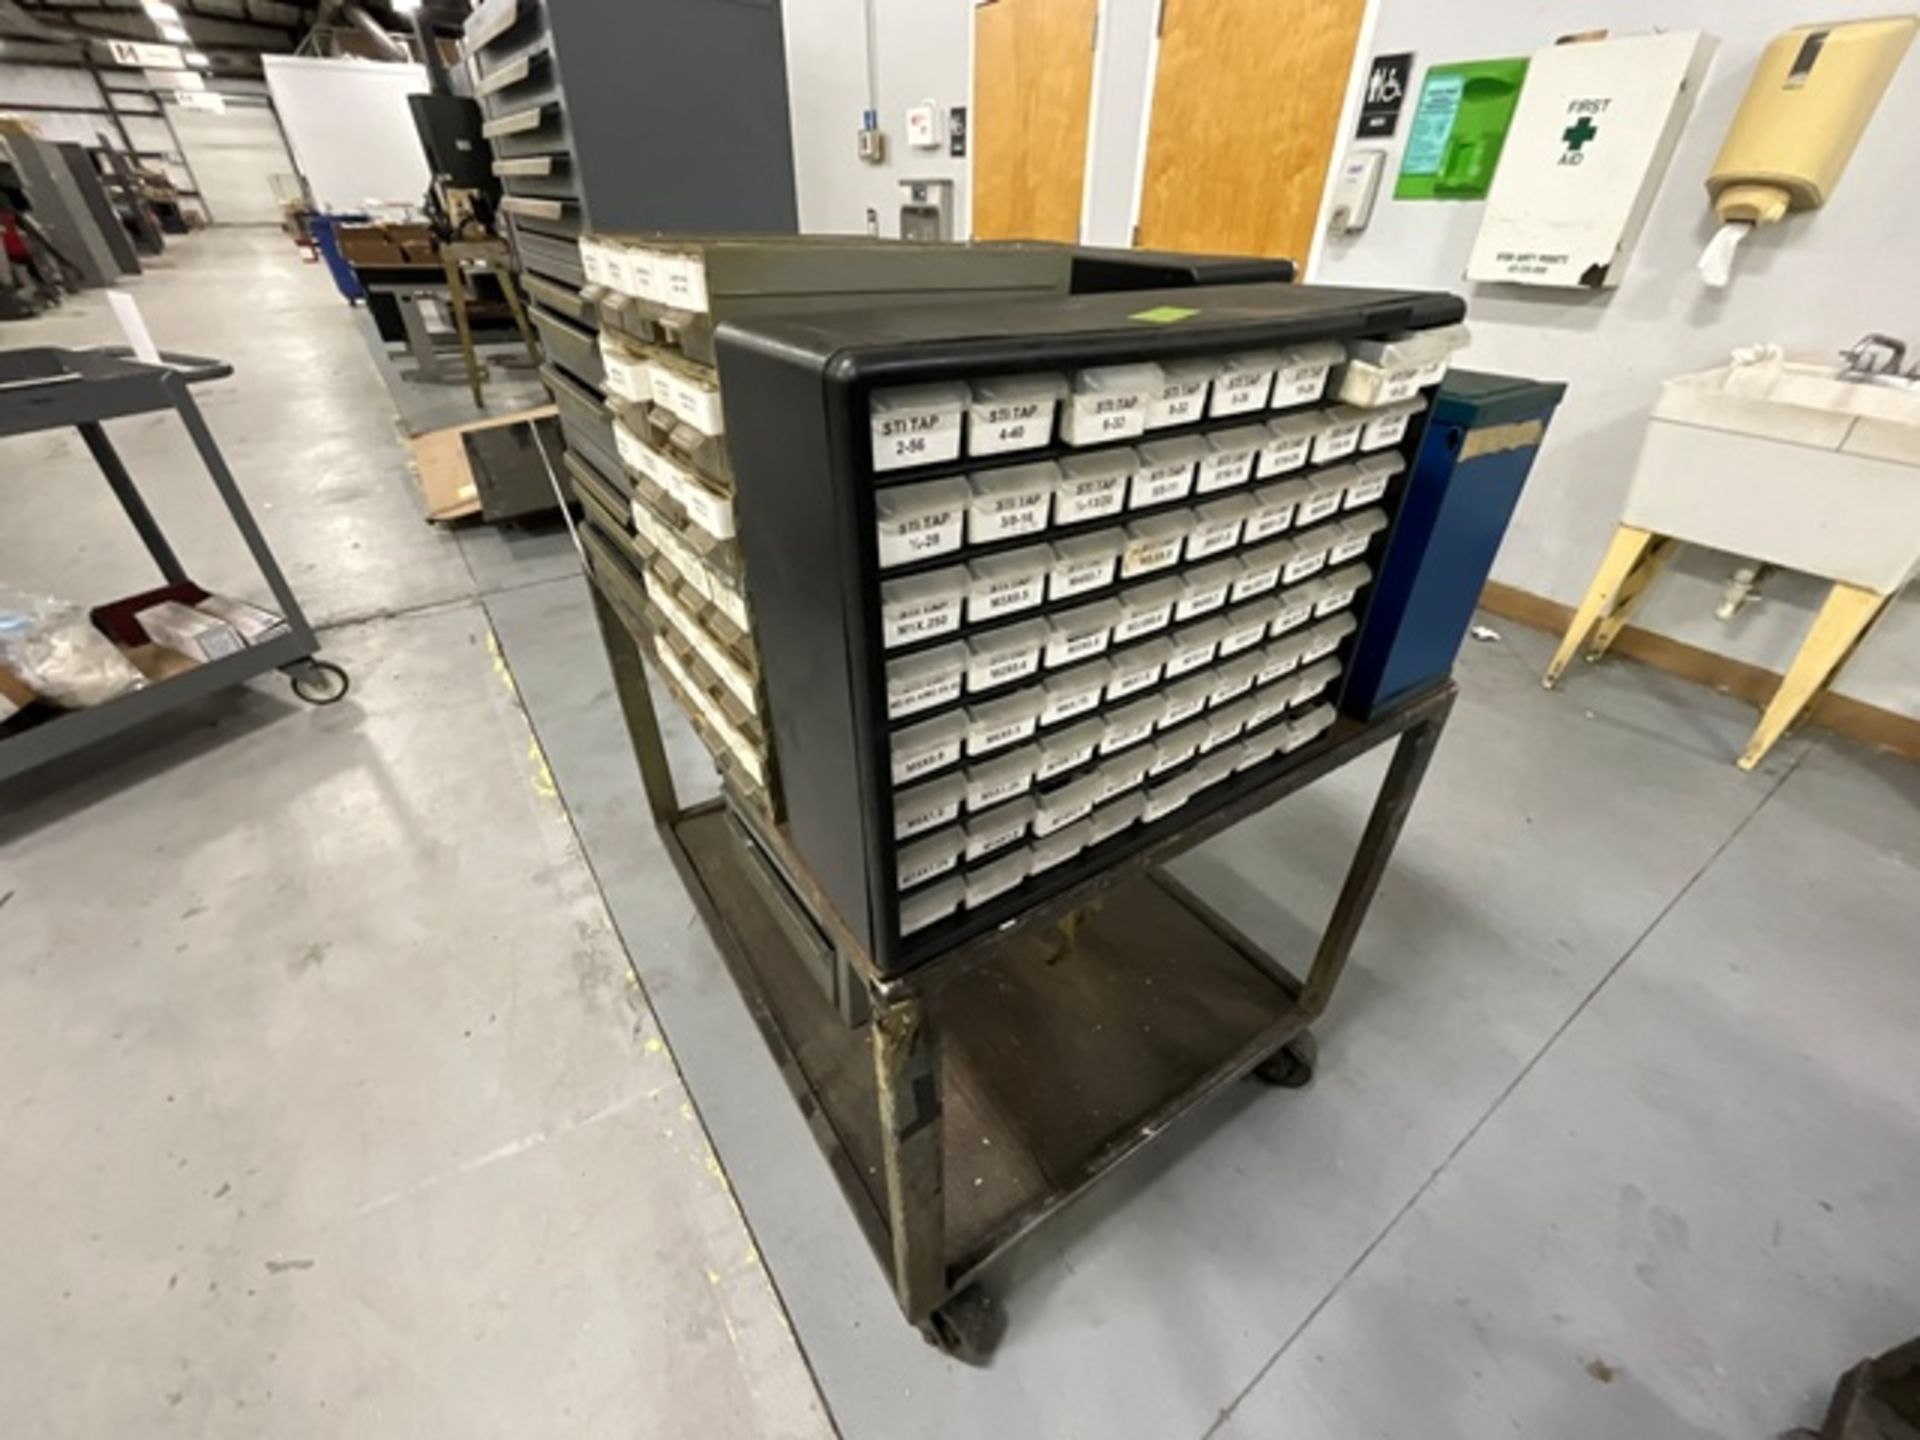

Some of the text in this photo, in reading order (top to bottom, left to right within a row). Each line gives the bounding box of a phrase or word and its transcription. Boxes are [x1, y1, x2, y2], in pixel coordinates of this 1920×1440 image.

[1567, 98, 1611, 114] FIRST
[1557, 152, 1585, 167] AID
[1116, 396, 1139, 411] TAP
[988, 404, 1038, 424] STI TAP
[882, 413, 940, 436] STI TAP
[898, 512, 949, 535] STI TAP
